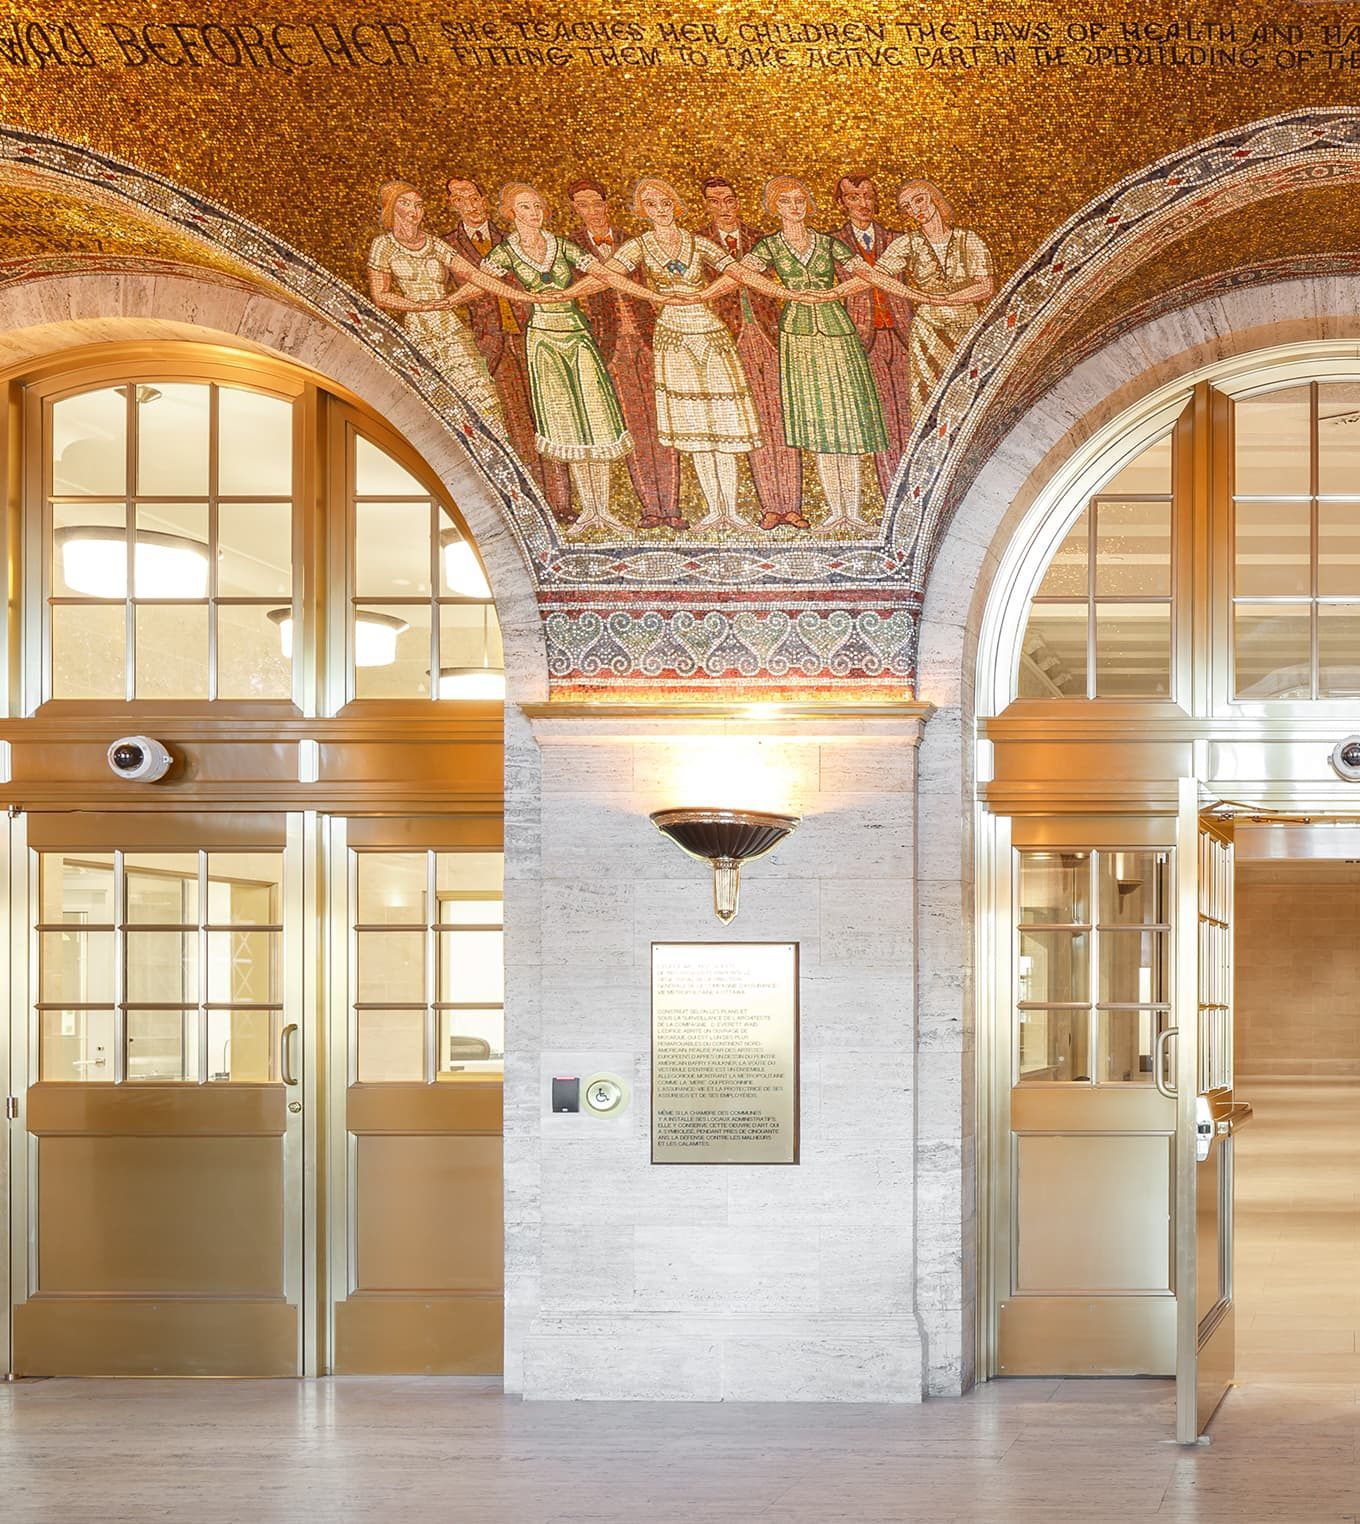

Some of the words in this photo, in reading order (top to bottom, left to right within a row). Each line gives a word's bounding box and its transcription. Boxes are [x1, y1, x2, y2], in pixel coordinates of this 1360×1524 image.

[441, 22, 504, 43] SHE
[511, 21, 647, 43] TEACHES
[659, 21, 728, 45] HER
[739, 22, 885, 45] CHILDREN
[972, 21, 1051, 42] LAWS
[1066, 22, 1108, 42] OF
[1120, 21, 1236, 45] HEALTH
[1250, 22, 1303, 46] AND
[0, 20, 97, 70] WAY
[102, 21, 309, 76] BEFORE
[309, 22, 430, 69] HER
[451, 46, 574, 67] FITTING
[578, 46, 663, 66] THEM
[670, 46, 708, 67] TO
[718, 46, 789, 71] TAKE
[806, 46, 902, 67] ACTIVE
[912, 46, 980, 70] PART
[993, 46, 1017, 66] IN
[1085, 46, 1264, 68] UPBUILDING
[1275, 49, 1316, 69] OF
